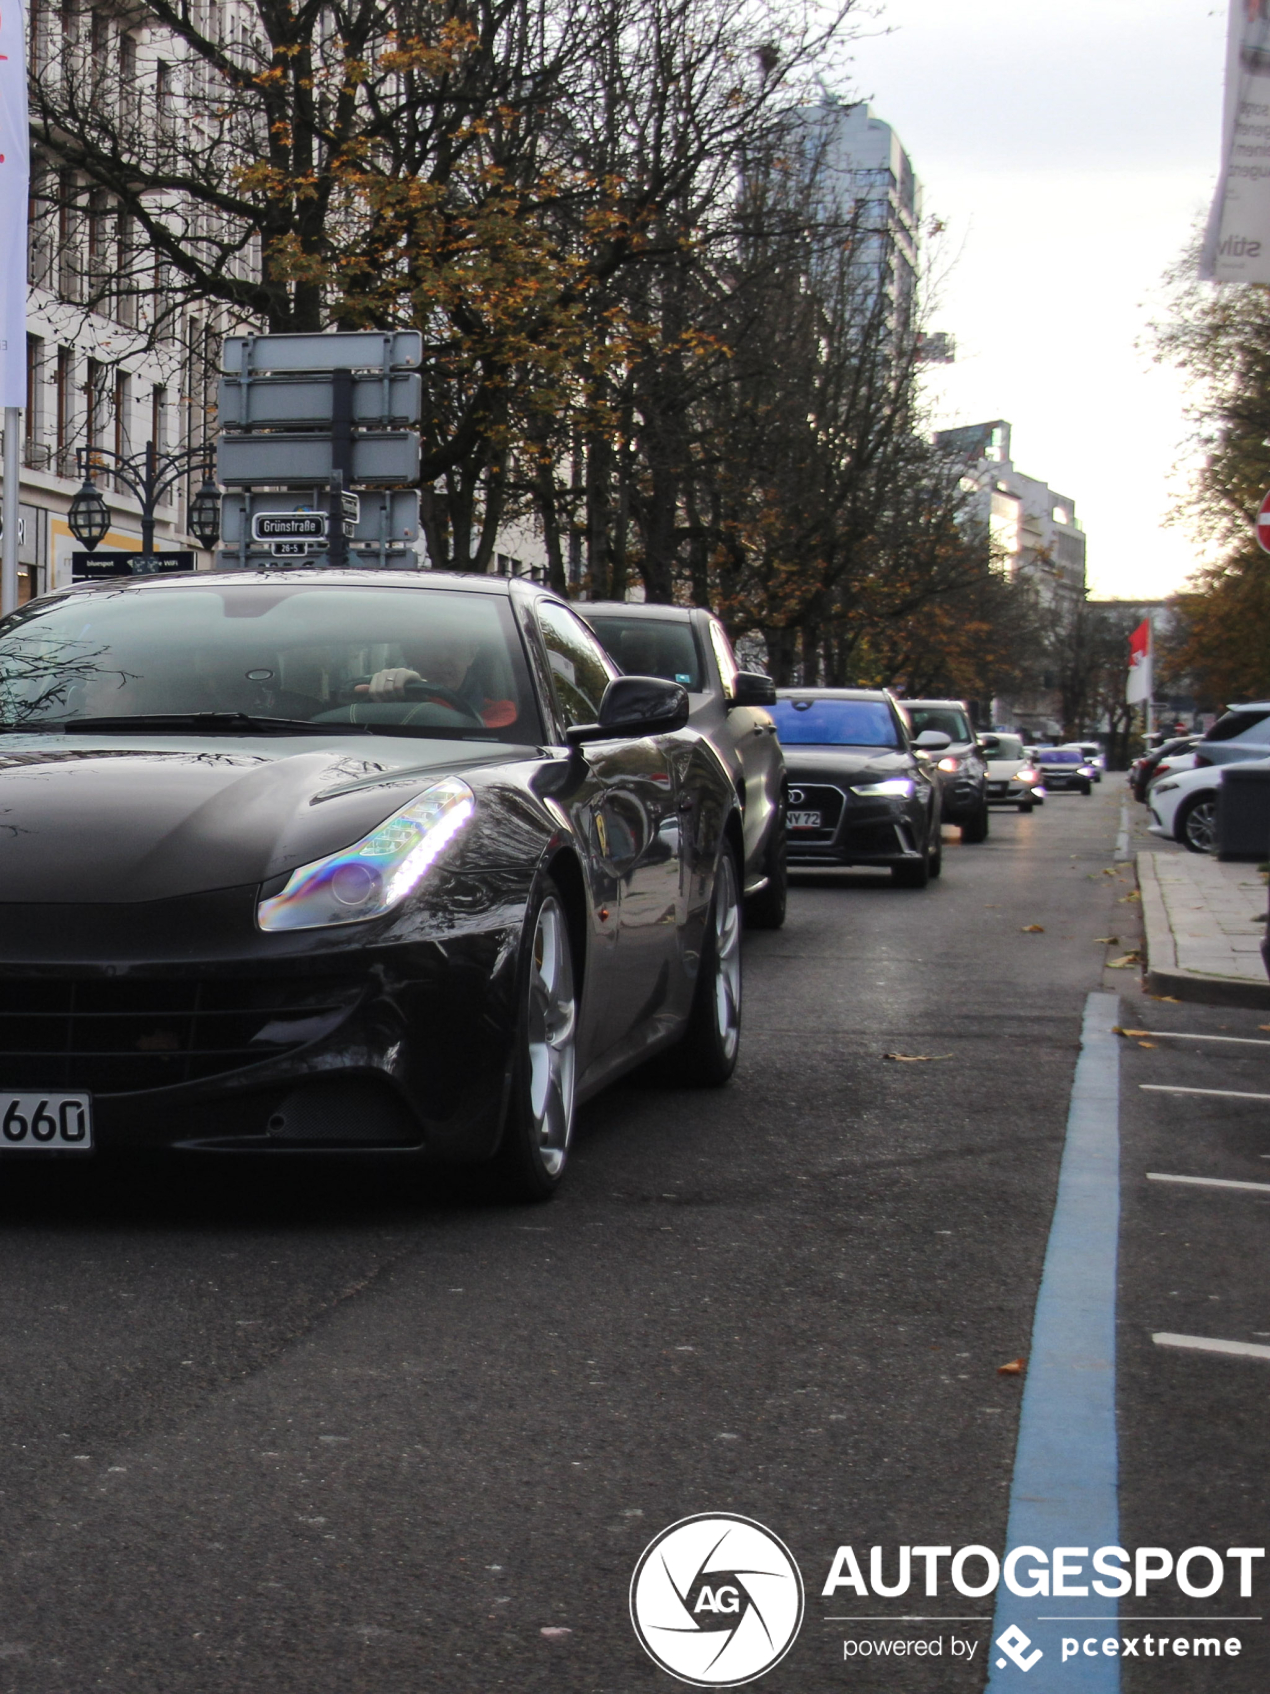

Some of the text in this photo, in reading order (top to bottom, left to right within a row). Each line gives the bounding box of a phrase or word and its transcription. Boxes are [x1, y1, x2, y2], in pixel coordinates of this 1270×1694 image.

[263, 519, 316, 532] Grünstraße
[803, 812, 820, 825] 72
[3, 1099, 86, 1142] 660
